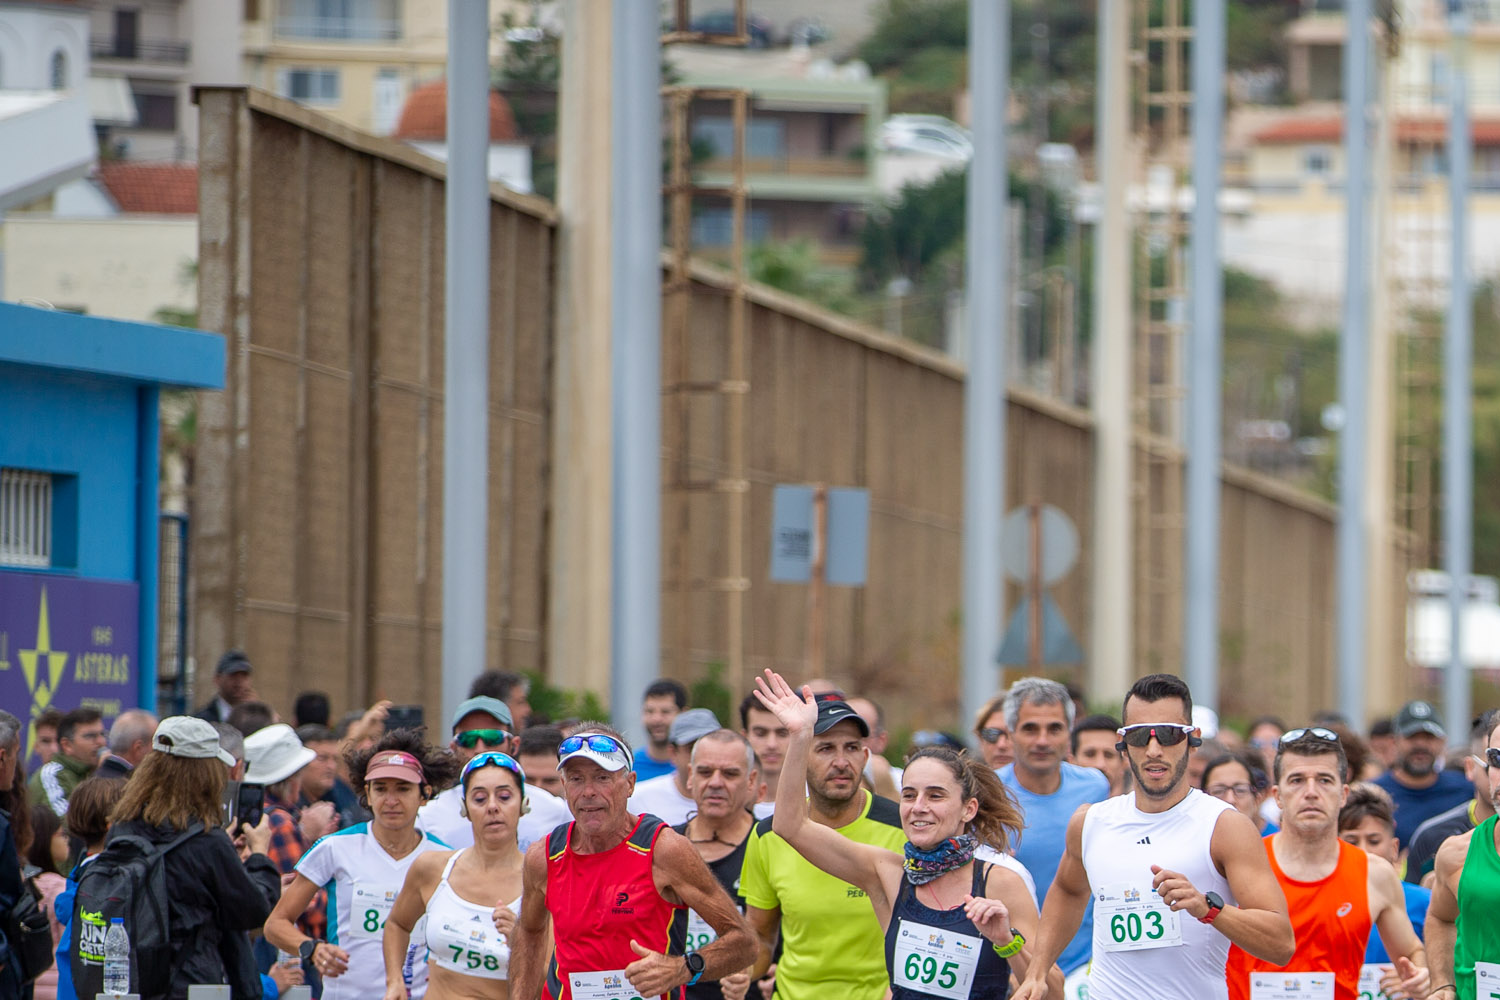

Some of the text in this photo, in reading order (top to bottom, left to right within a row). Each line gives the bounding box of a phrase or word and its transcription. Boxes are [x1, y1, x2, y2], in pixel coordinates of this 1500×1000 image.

[1110, 910, 1165, 943] 603
[448, 944, 500, 971] 758
[904, 953, 960, 990] 695
